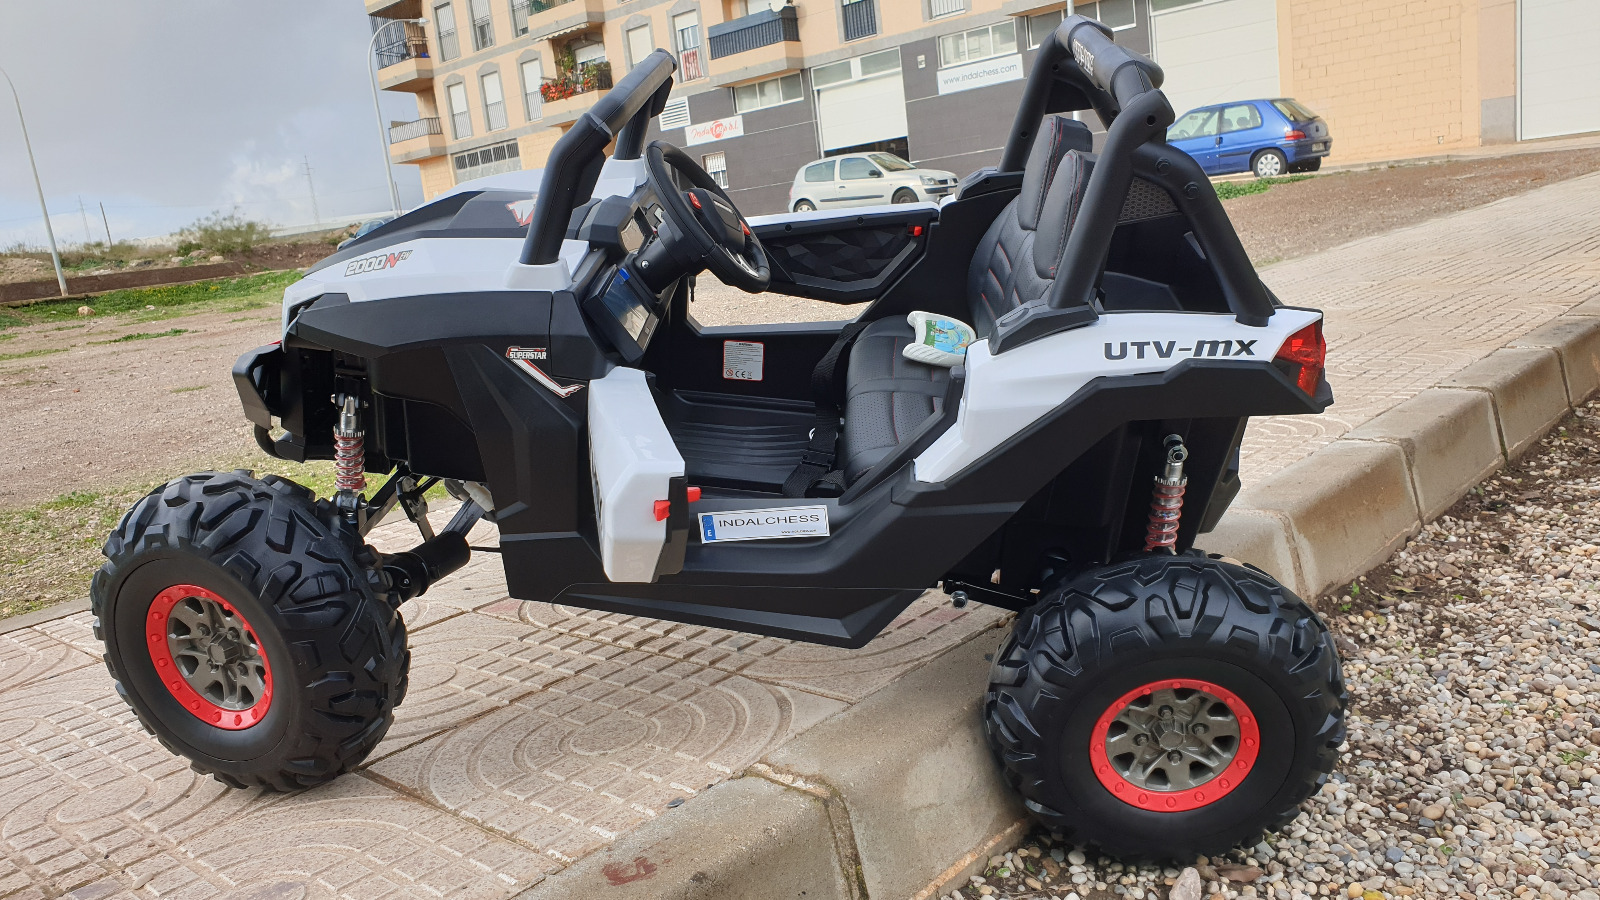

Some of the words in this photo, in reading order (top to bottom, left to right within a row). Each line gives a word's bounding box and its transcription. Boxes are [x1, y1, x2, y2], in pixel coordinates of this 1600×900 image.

[942, 64, 1018, 85] www.indalchess.com
[509, 351, 547, 360] SUPERSTAR
[718, 514, 820, 527] INDALCHESS
[707, 529, 713, 537] E
